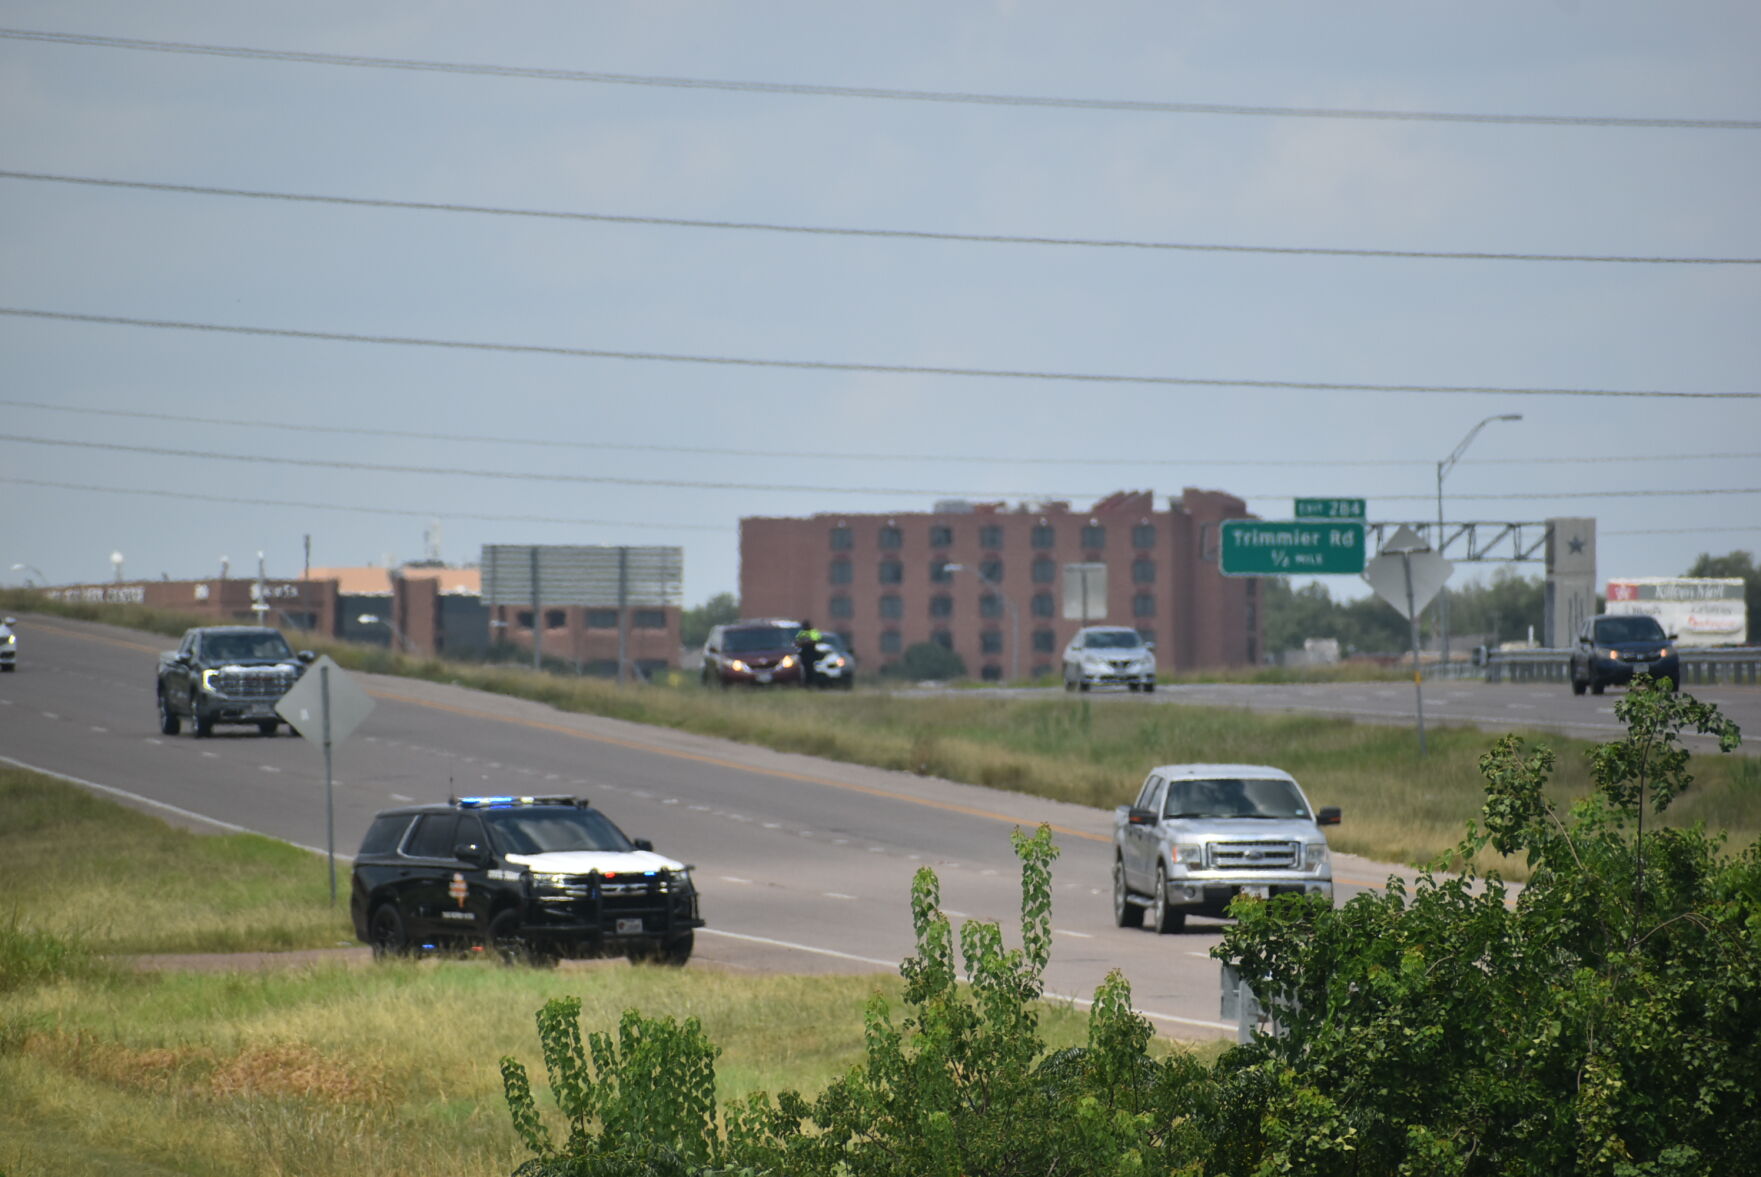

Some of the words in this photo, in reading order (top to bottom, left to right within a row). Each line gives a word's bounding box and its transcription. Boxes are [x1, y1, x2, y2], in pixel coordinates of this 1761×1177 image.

[1329, 501, 1360, 516] 284
[1232, 529, 1320, 546] Trimmier
[1330, 529, 1355, 547] Rd
